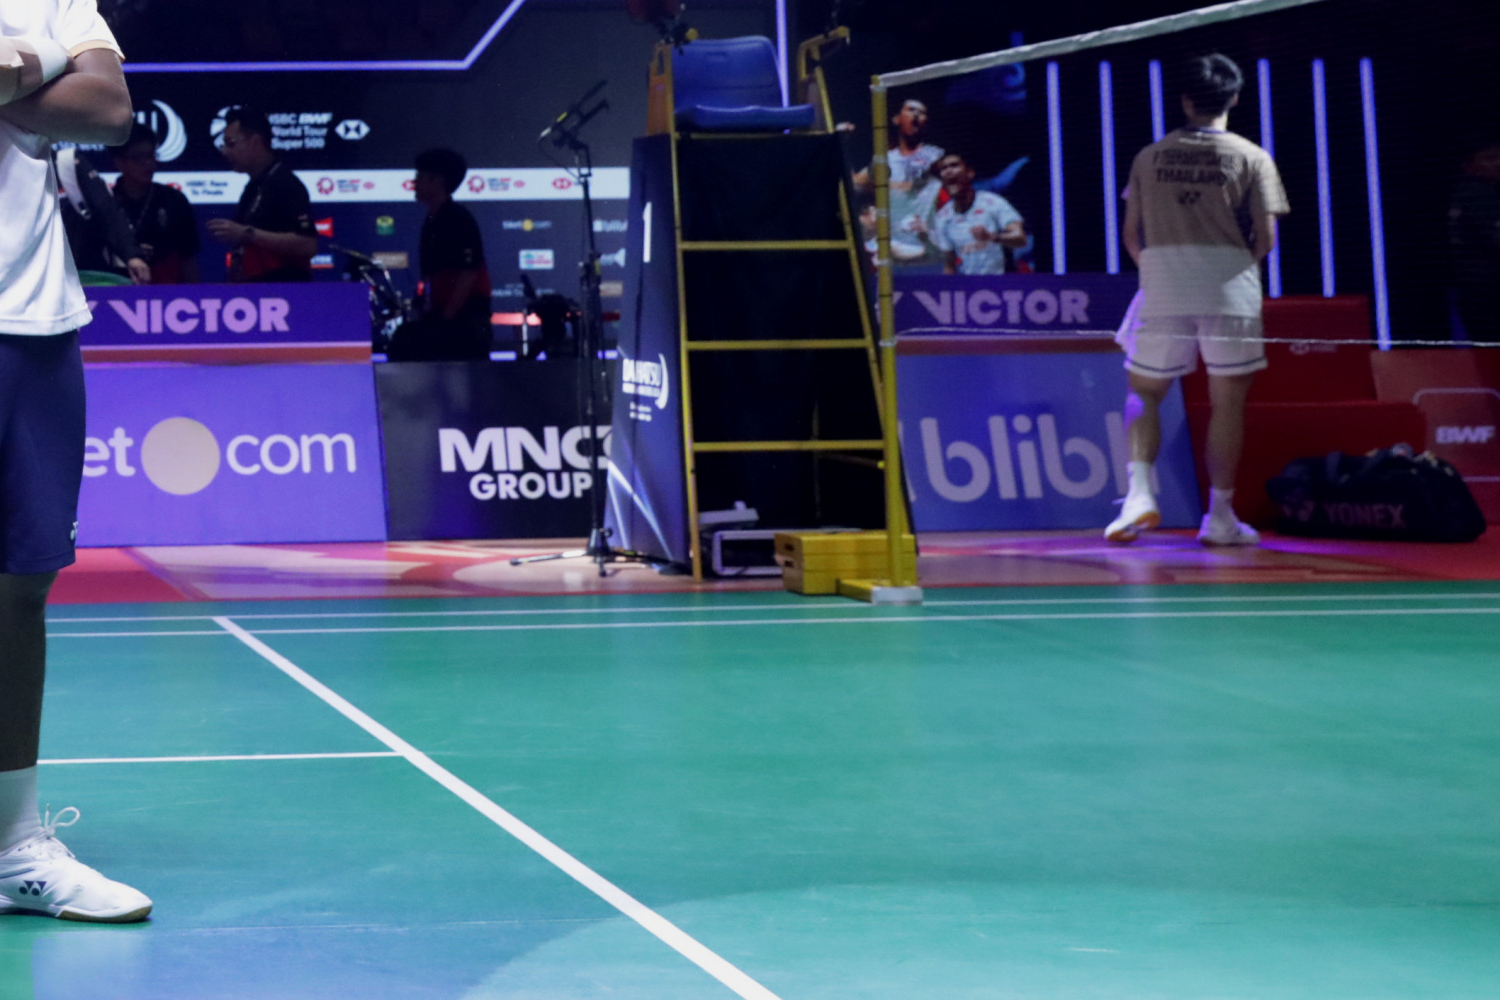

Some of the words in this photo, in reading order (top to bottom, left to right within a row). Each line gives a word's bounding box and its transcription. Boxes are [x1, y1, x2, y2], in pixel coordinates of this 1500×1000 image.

[271, 125, 302, 137] World
[303, 125, 328, 137] Tour
[271, 137, 303, 150] Super
[107, 297, 290, 334] VICTOR
[912, 288, 1090, 325] VICTOR
[1435, 425, 1496, 444] BWF
[226, 433, 357, 475] com
[919, 411, 1160, 503] blibl
[469, 471, 592, 501] GROUP
[1323, 501, 1405, 529] YONEX
